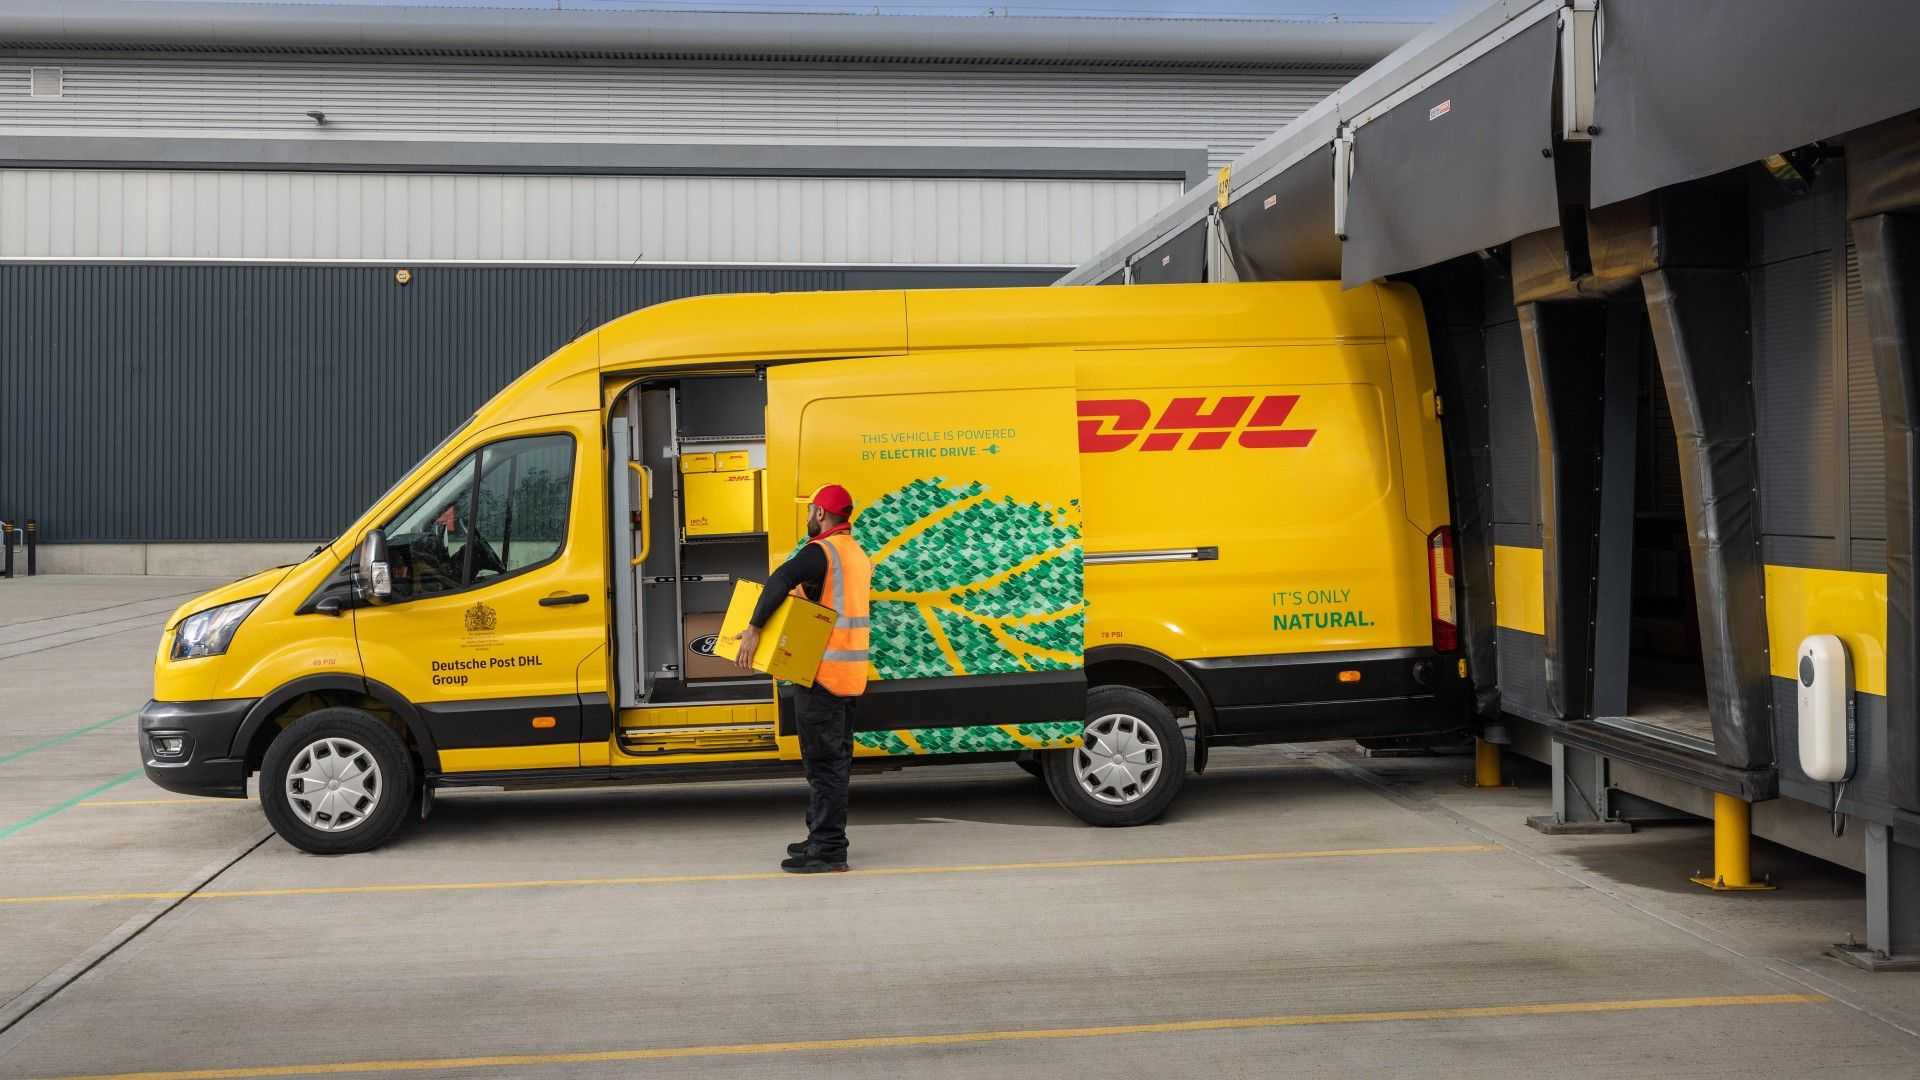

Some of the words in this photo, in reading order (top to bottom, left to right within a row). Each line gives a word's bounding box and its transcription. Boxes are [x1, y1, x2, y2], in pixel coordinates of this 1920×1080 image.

[1077, 395, 1317, 453] DHL
[862, 434, 888, 444] THIS
[891, 431, 940, 443] VEHICLE
[944, 430, 953, 441] IS
[957, 428, 1015, 440] POWERED
[862, 451, 877, 461] BY
[879, 448, 936, 460] ELECTRIC
[940, 446, 976, 457] DRIVE
[1273, 591, 1302, 606] IT'S
[1307, 588, 1351, 605] ONLY
[1273, 611, 1375, 631] NATURAL.
[432, 658, 487, 671] Deutsche
[489, 657, 515, 668] Post
[518, 655, 543, 667] DHL
[432, 674, 469, 685] Group
